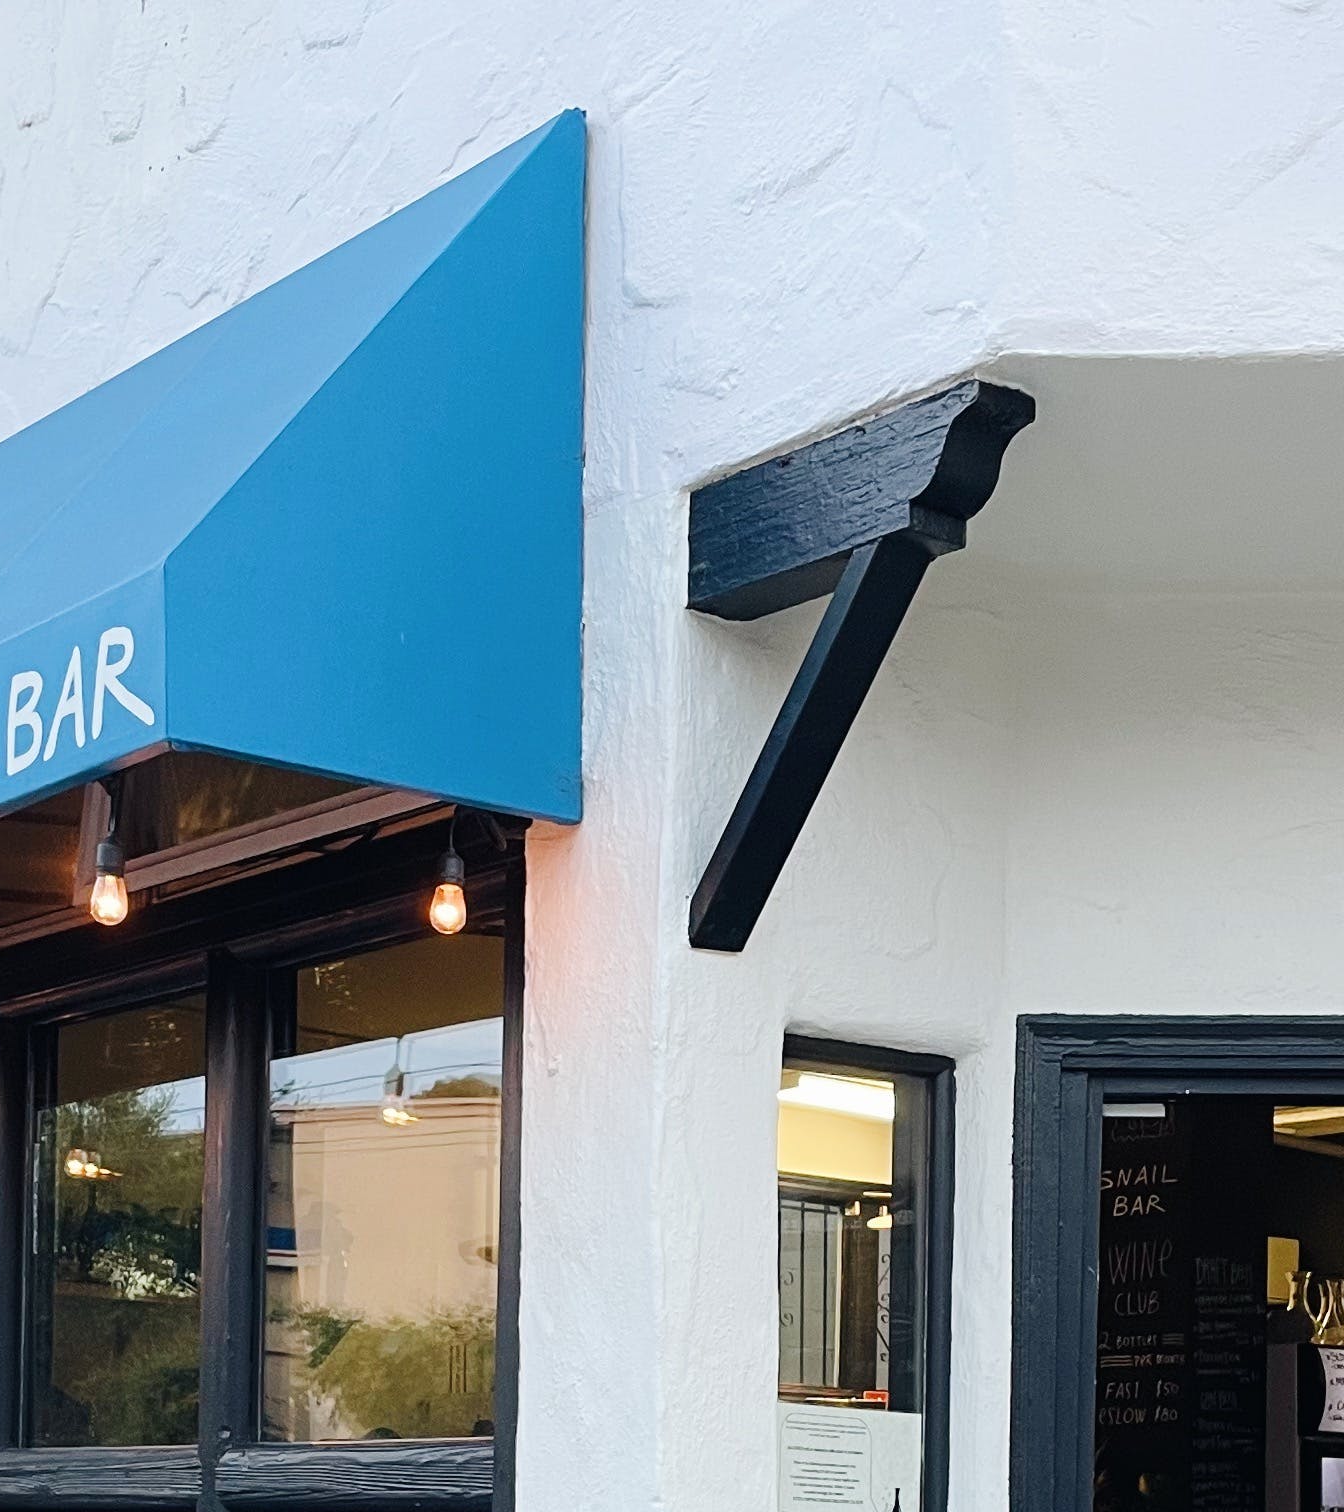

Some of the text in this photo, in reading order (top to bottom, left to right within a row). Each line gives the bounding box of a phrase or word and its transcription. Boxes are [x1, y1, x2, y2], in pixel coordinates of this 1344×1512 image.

[6, 625, 156, 774] BAR
[1100, 1165, 1179, 1190] SNAIL
[1113, 1194, 1166, 1216] BAR
[1114, 1290, 1160, 1316] CLUB
